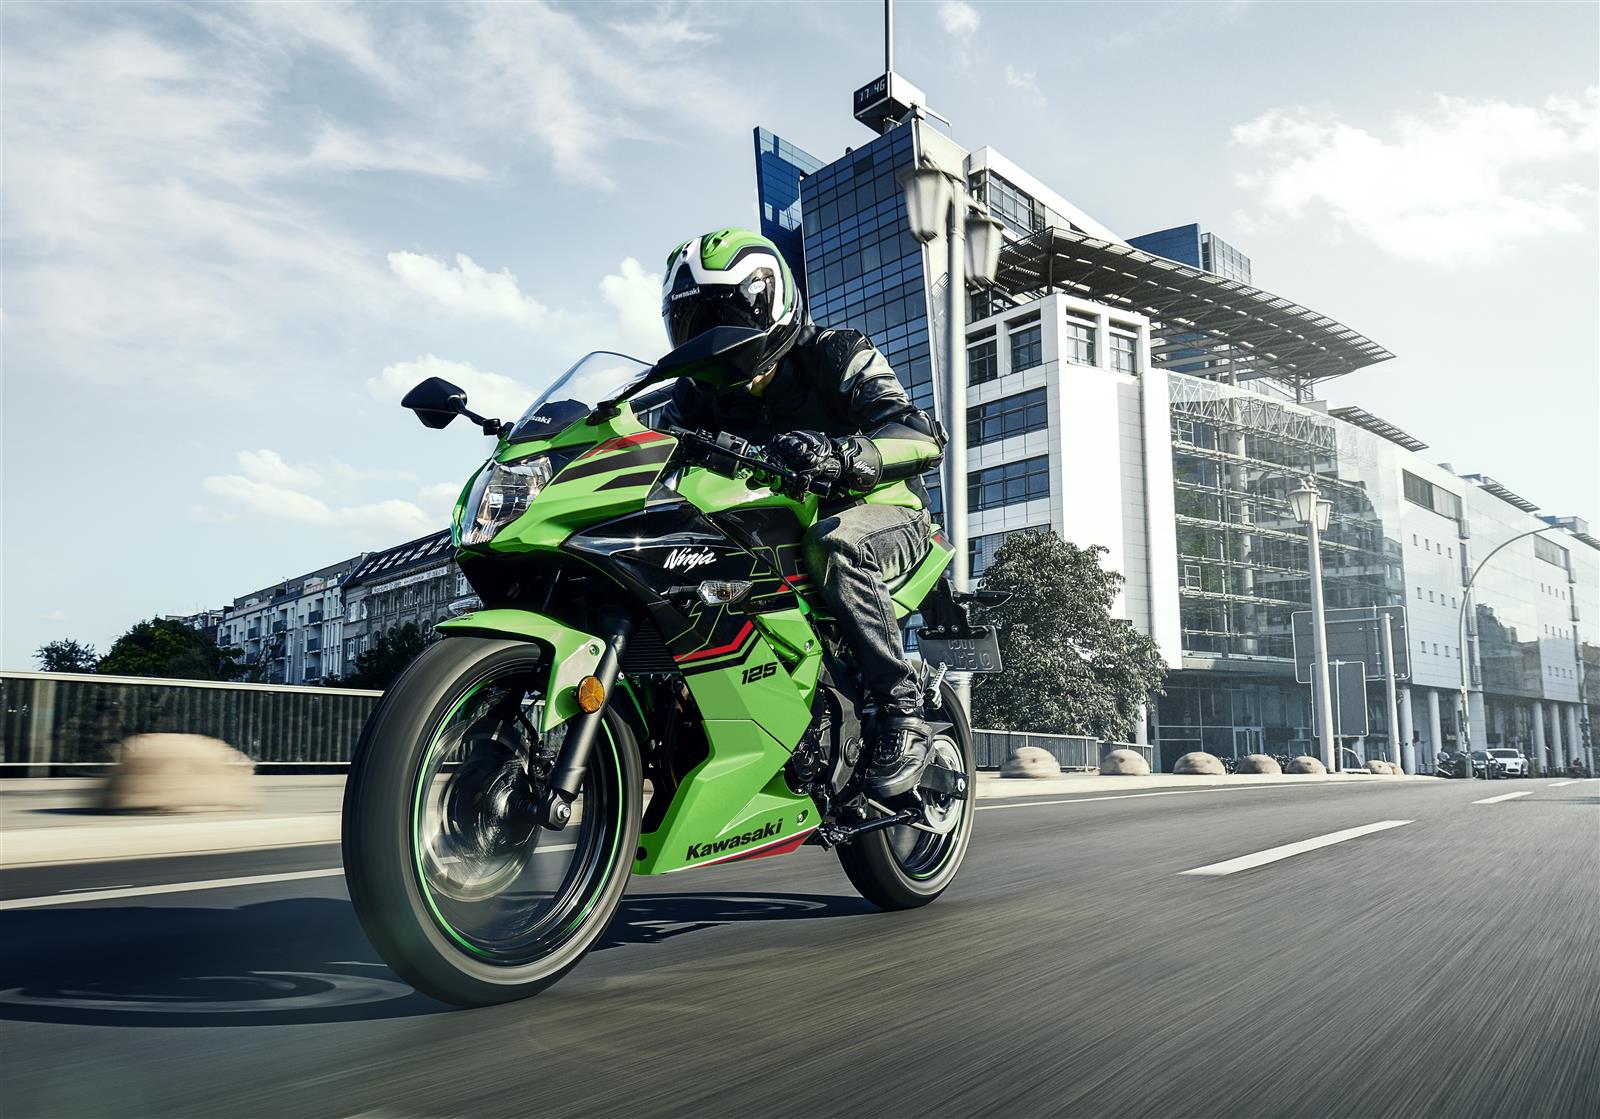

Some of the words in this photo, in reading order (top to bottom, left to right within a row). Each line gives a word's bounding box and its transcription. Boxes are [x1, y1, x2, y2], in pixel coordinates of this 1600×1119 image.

[671, 286, 700, 301] Kawasaki
[853, 460, 876, 476] Ninja
[663, 546, 717, 573] Ninja
[741, 661, 778, 685] 125
[685, 818, 784, 861] Kawasaki
